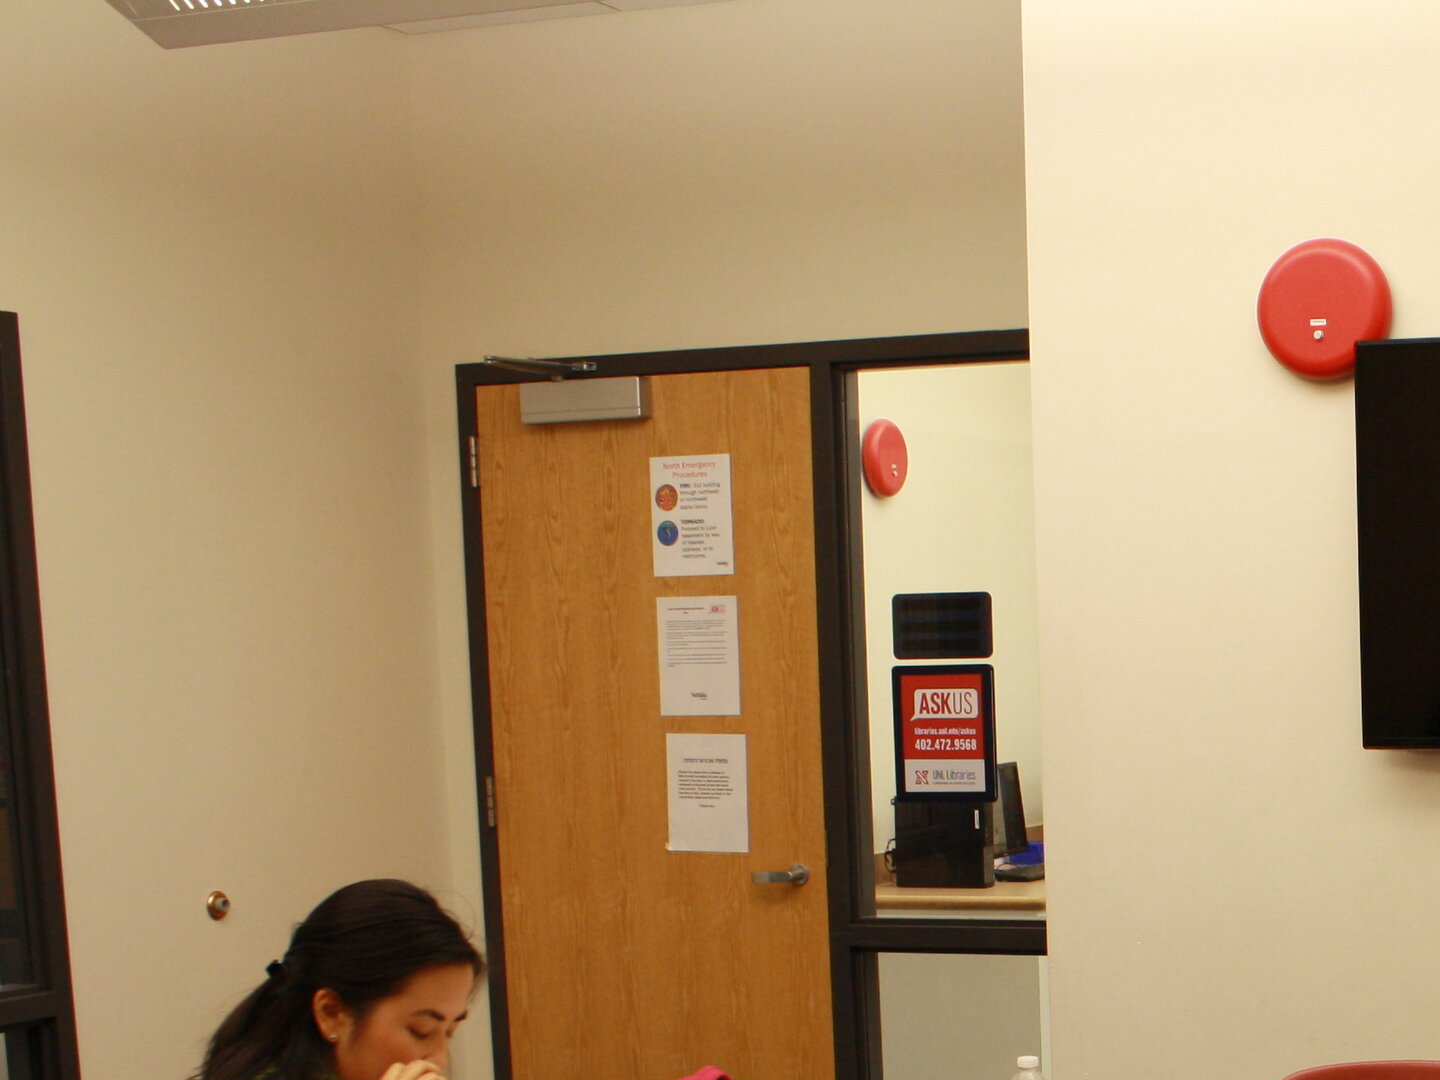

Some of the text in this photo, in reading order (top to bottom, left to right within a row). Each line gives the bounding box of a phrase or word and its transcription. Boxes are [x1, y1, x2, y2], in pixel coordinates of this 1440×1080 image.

[682, 462, 715, 470] Emergency
[914, 738, 977, 751] 402.472.9568
[932, 770, 944, 780] UNL
[946, 770, 976, 781] Libraries
